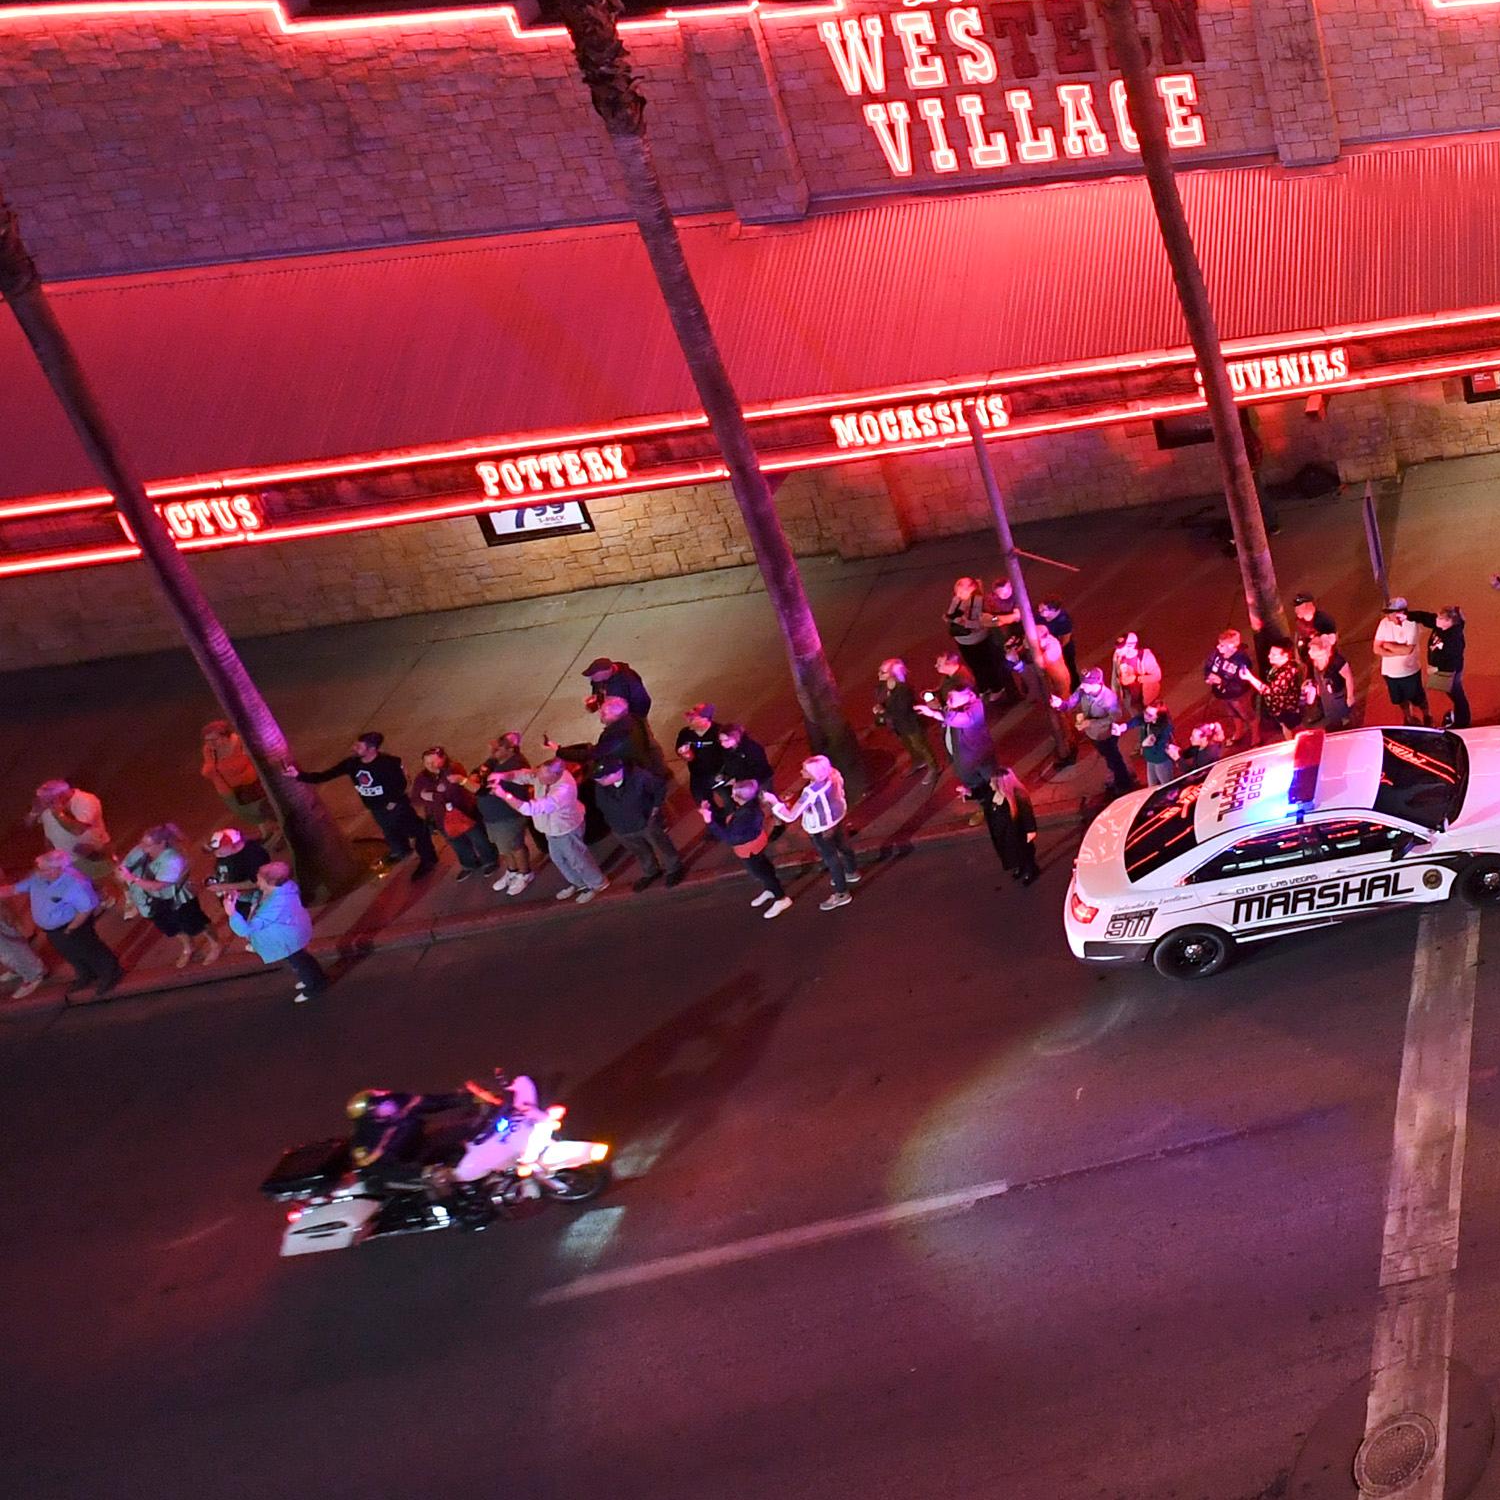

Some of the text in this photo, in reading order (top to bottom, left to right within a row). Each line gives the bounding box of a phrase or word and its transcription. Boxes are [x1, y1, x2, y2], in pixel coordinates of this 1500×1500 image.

[476, 443, 629, 498] POTTERY
[1216, 760, 1252, 822] MARSHAL
[1233, 872, 1416, 925] MARSHAL
[1236, 874, 1318, 895] CITY OF LAS VEGAS
[1104, 915, 1154, 940] 911
